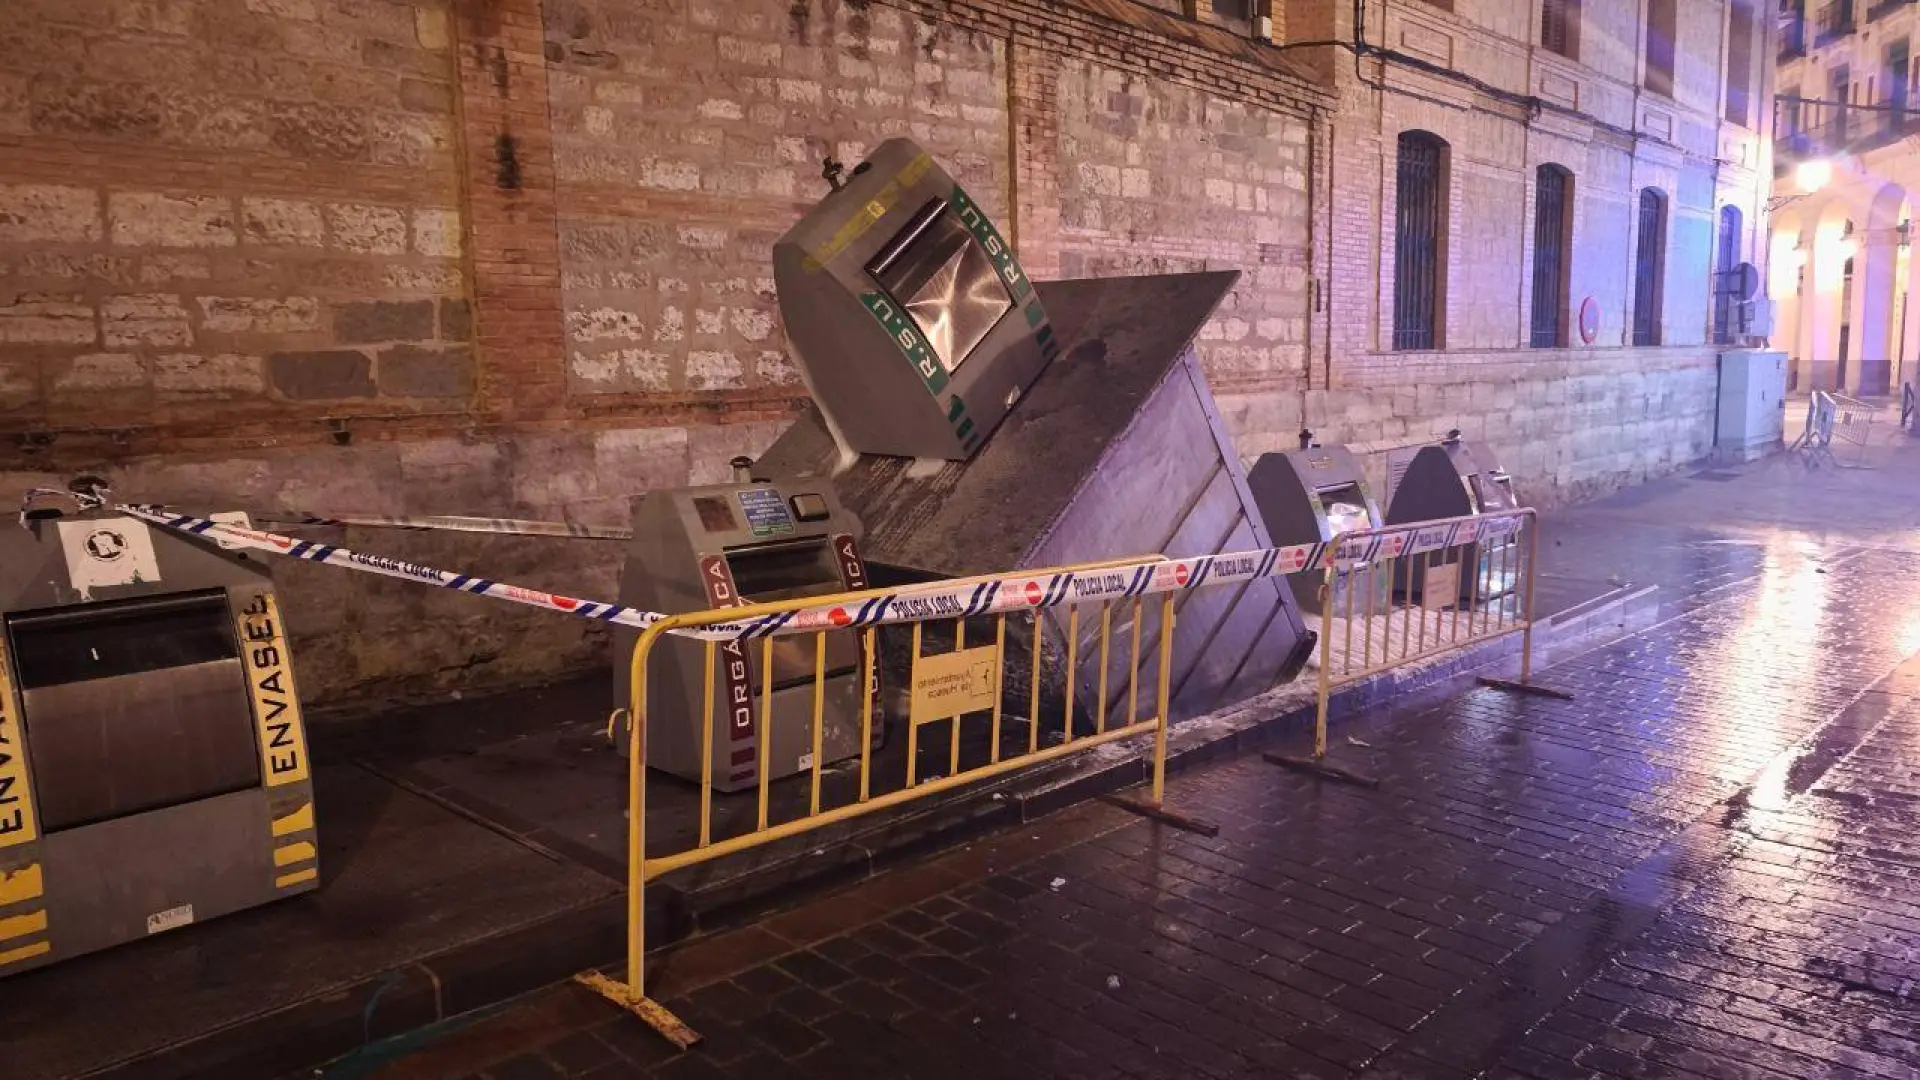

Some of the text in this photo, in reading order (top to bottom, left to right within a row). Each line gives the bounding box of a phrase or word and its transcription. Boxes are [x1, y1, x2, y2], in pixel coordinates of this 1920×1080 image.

[1073, 573, 1126, 598] POLICIA LOCAL
[891, 593, 964, 620] POLICIA LOCAL
